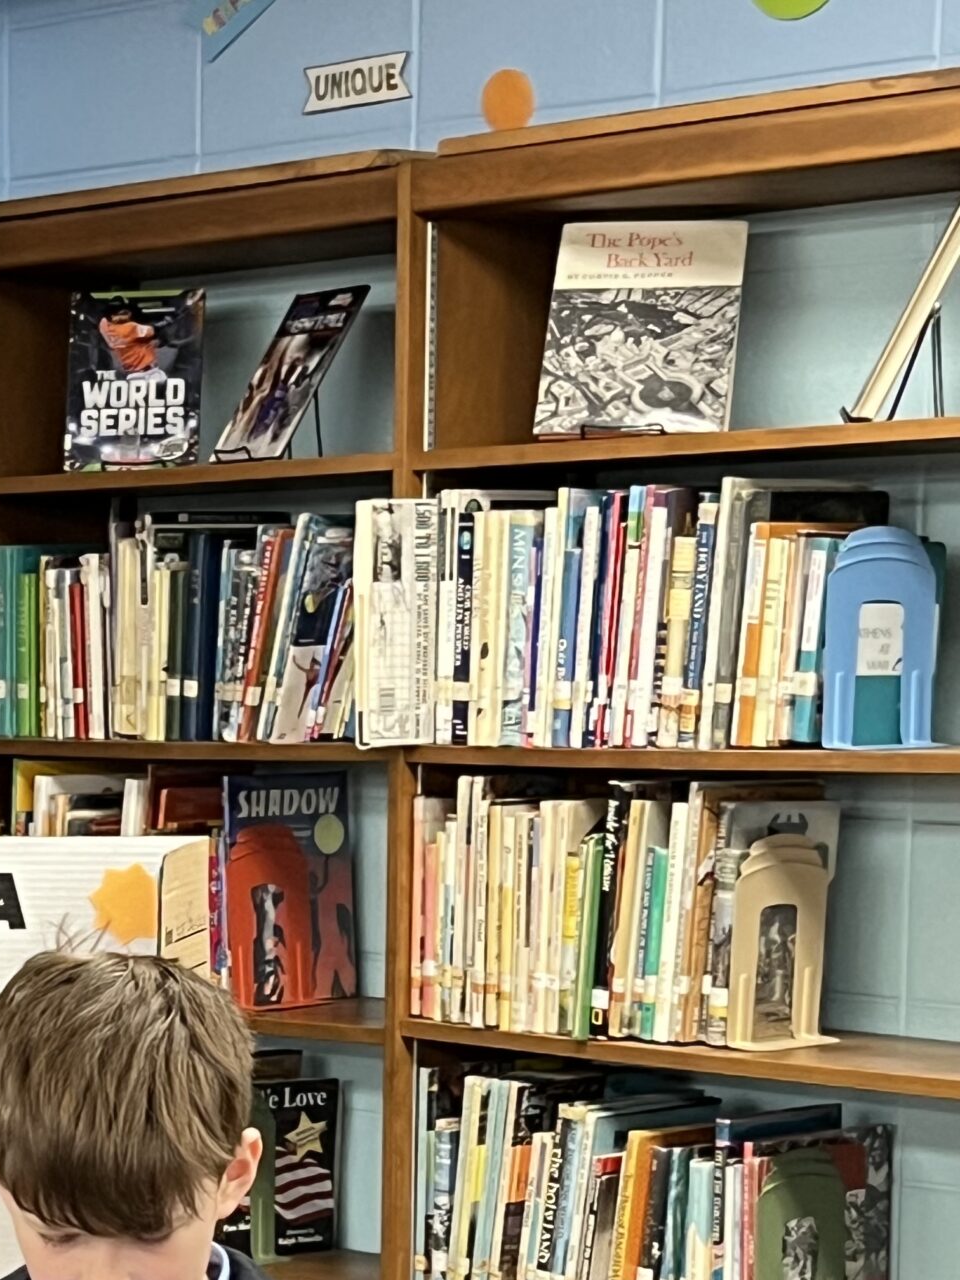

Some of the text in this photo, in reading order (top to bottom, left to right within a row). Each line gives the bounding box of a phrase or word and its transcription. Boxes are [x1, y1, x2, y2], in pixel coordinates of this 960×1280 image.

[314, 63, 398, 101] UNIQUE
[628, 231, 683, 250] Pope's
[653, 251, 694, 268] Yard
[96, 370, 117, 381] THE
[81, 378, 186, 408] WORLD
[80, 406, 186, 436] SERIES
[695, 547, 709, 583] HOLY
[692, 584, 706, 618] LAND
[237, 786, 339, 818] SHADOW
[283, 1087, 328, 1108] Love
